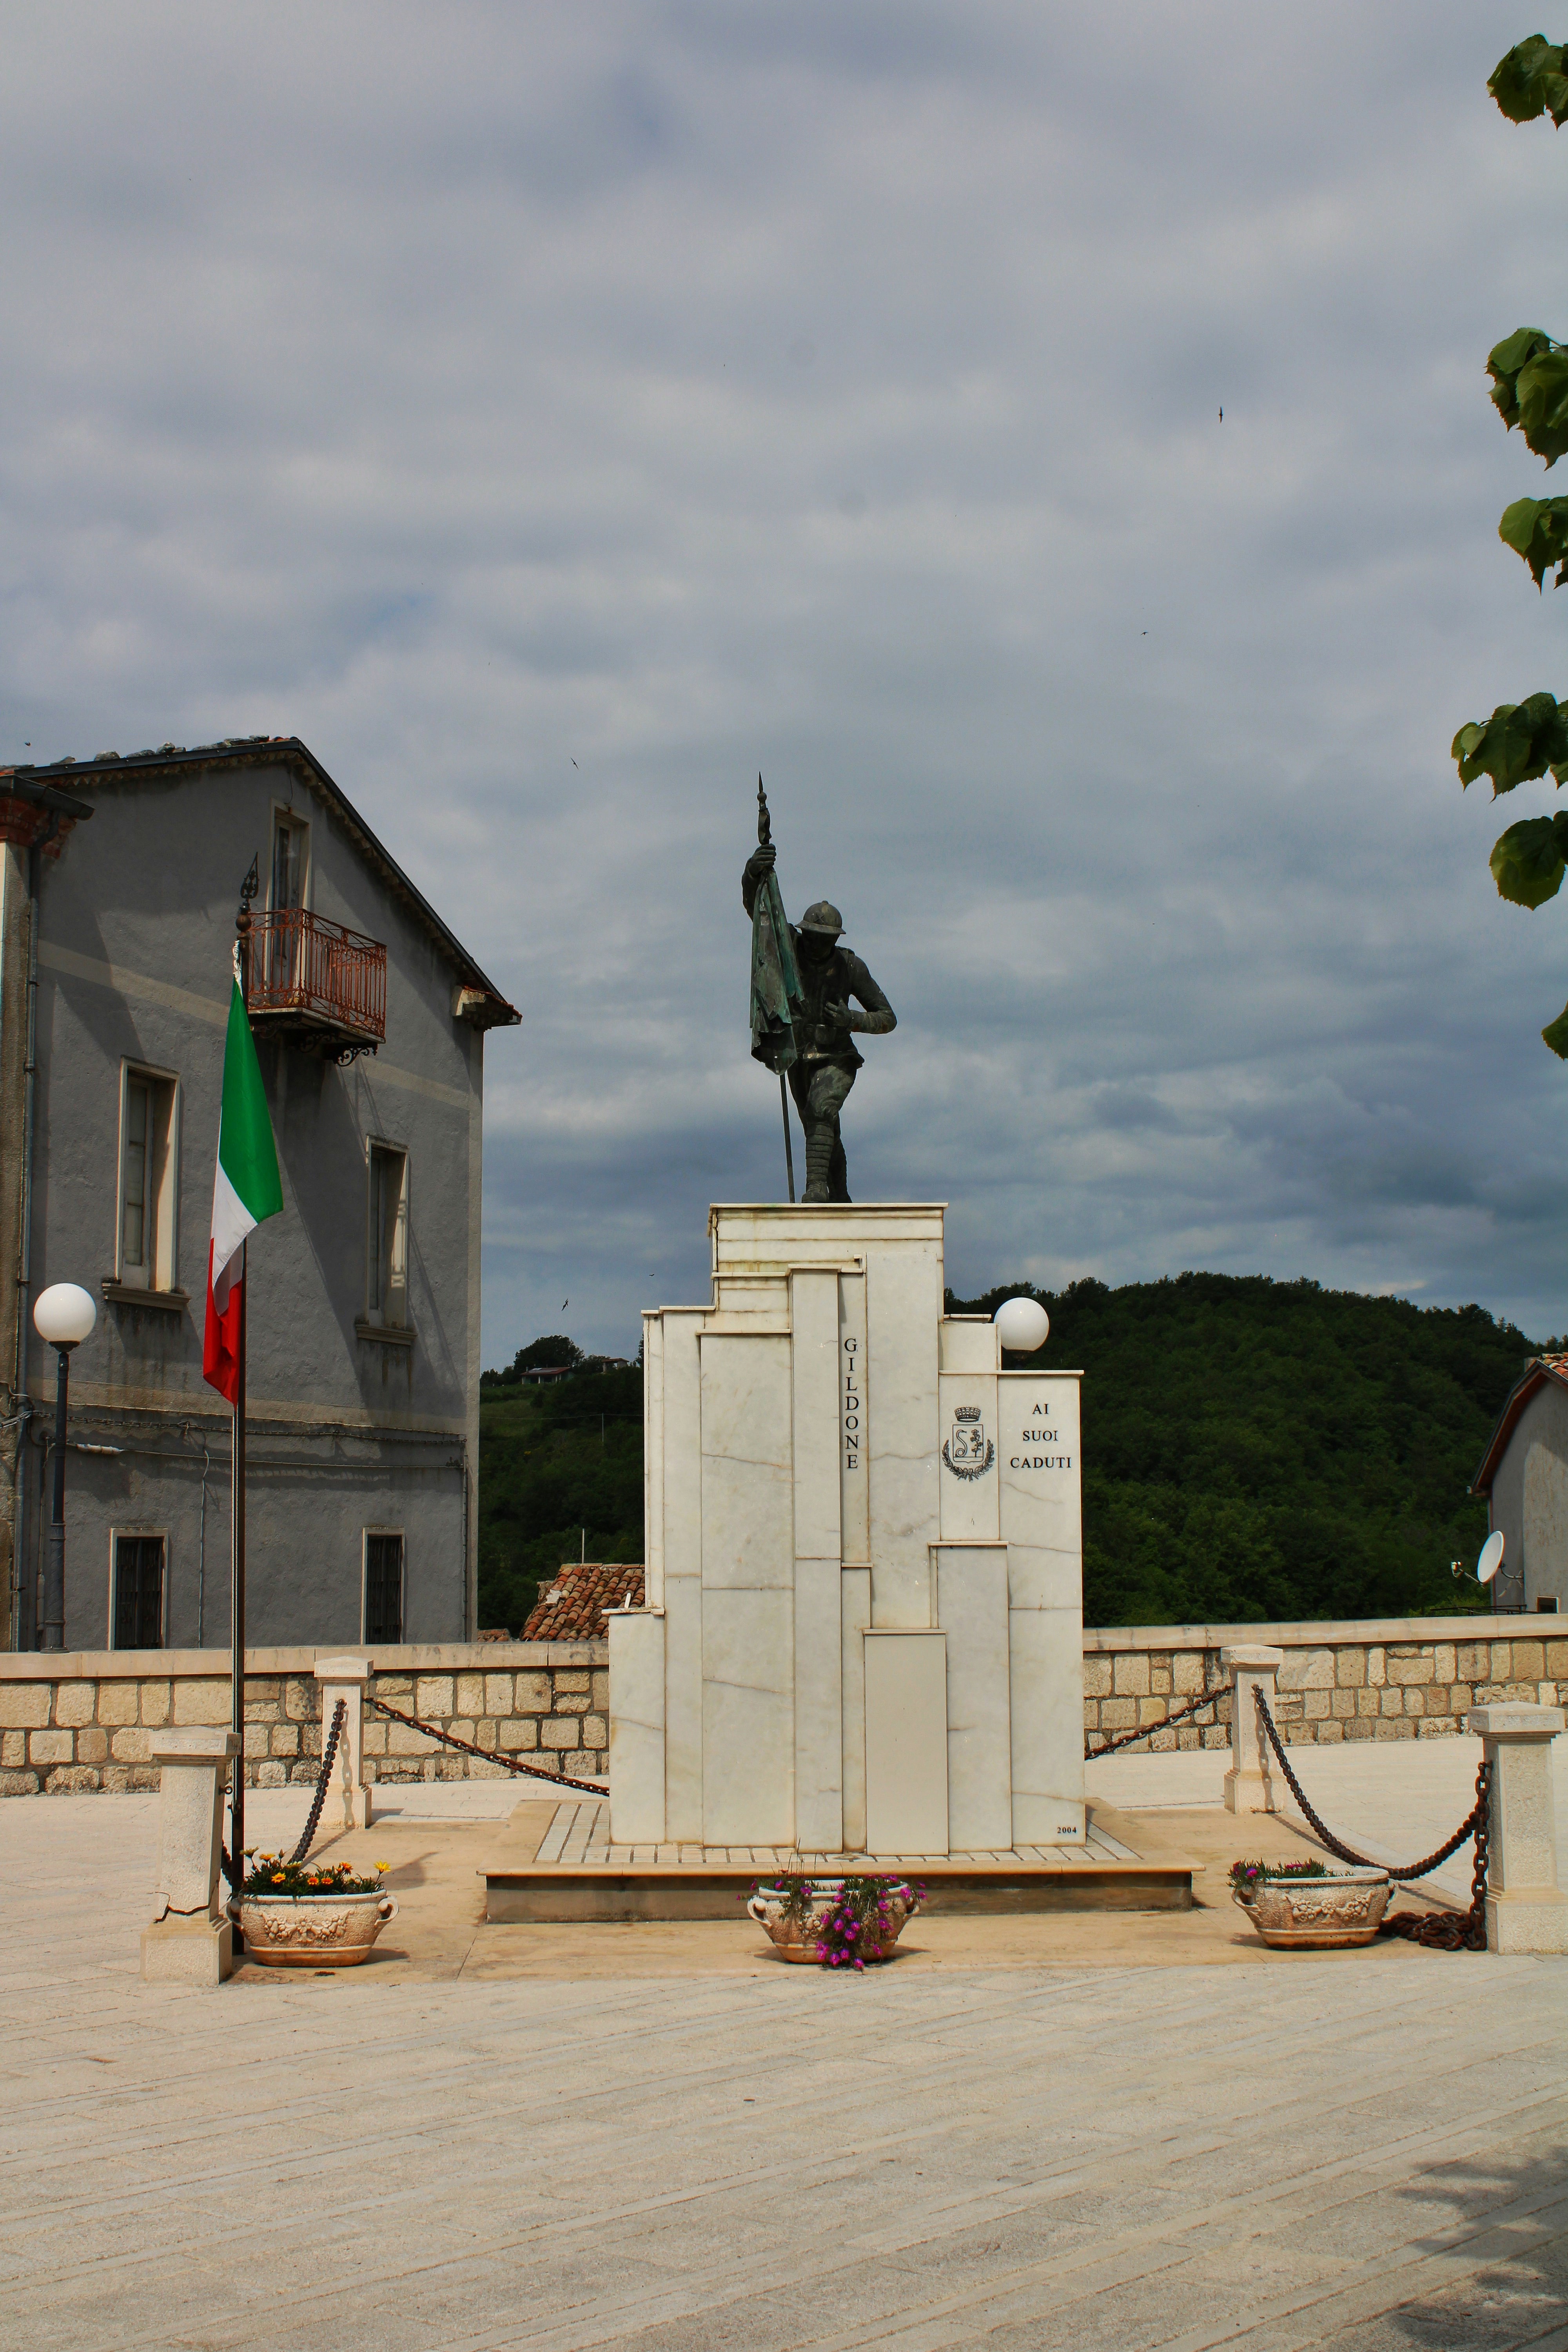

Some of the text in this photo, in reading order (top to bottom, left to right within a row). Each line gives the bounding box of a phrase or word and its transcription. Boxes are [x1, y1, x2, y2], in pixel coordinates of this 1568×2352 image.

[844, 1338, 859, 1469] GILDONE
[1032, 1403, 1049, 1414] AI
[1023, 1430, 1058, 1441] SUOI
[1010, 1457, 1071, 1468] CADUTI
